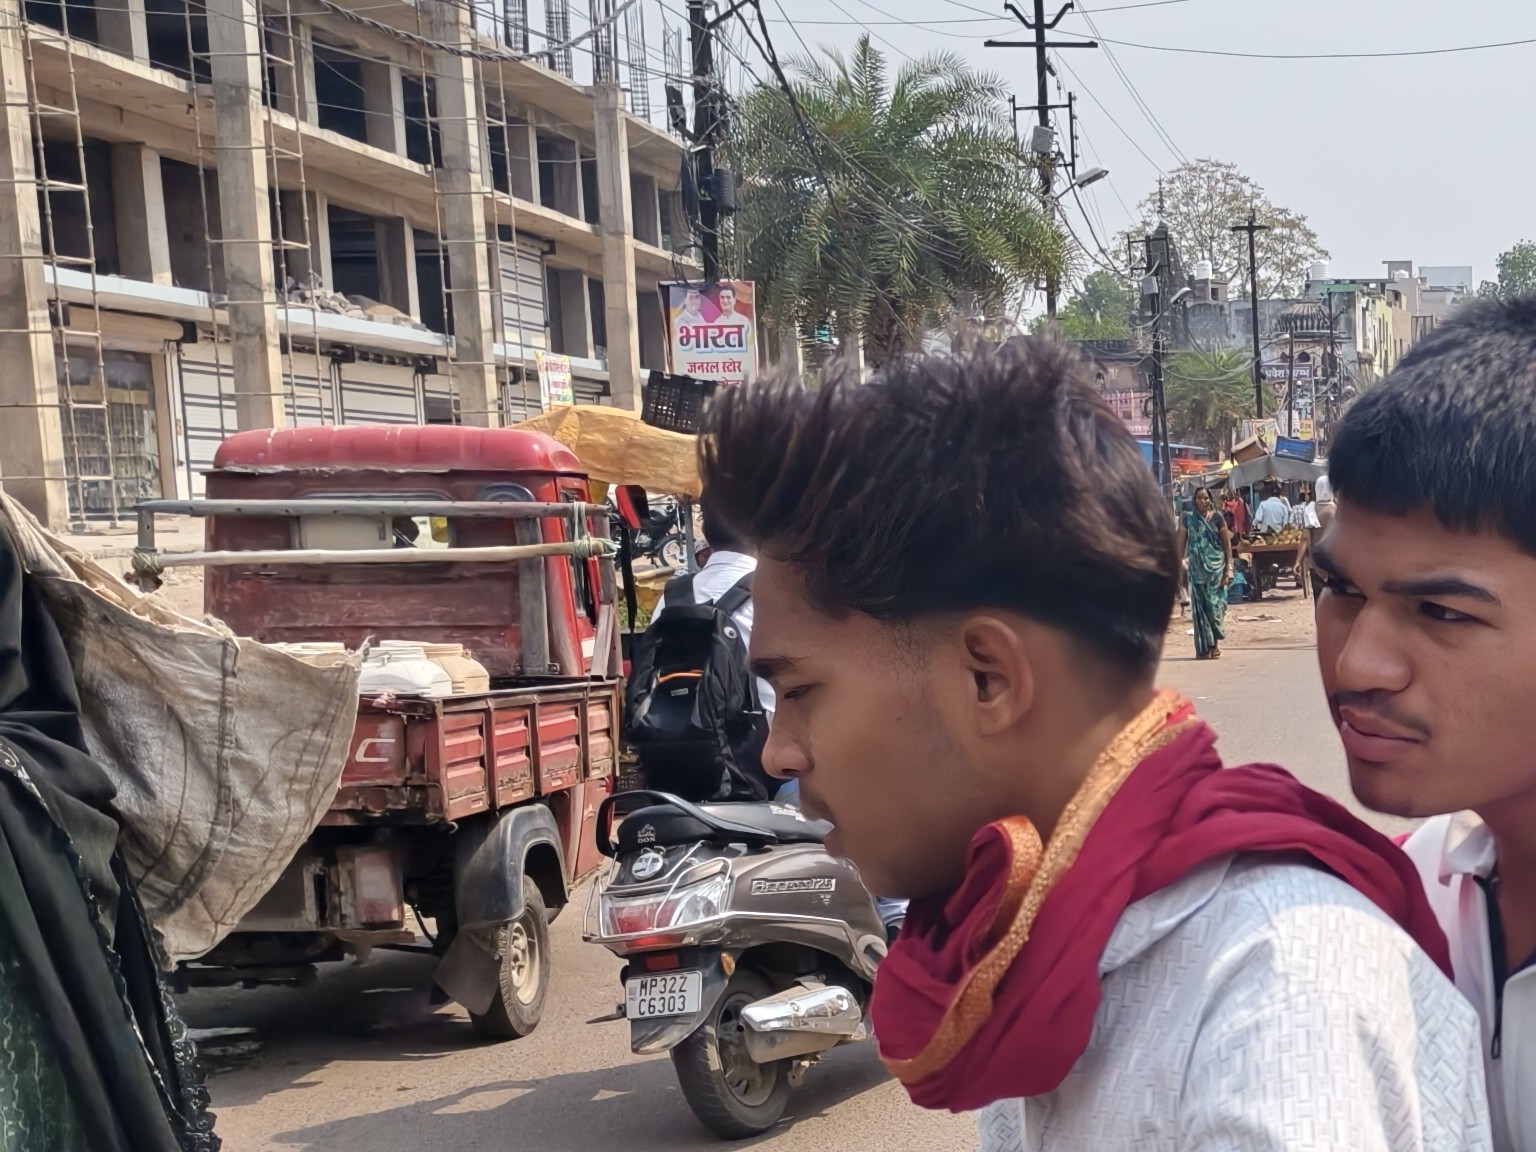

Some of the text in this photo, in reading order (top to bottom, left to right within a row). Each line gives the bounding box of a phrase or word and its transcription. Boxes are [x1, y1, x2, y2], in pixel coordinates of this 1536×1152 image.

[679, 324, 745, 349] भारत
[687, 358, 743, 374] जनरल स्टोर
[640, 976, 687, 996] MP32Z
[639, 995, 686, 1015] C6303
